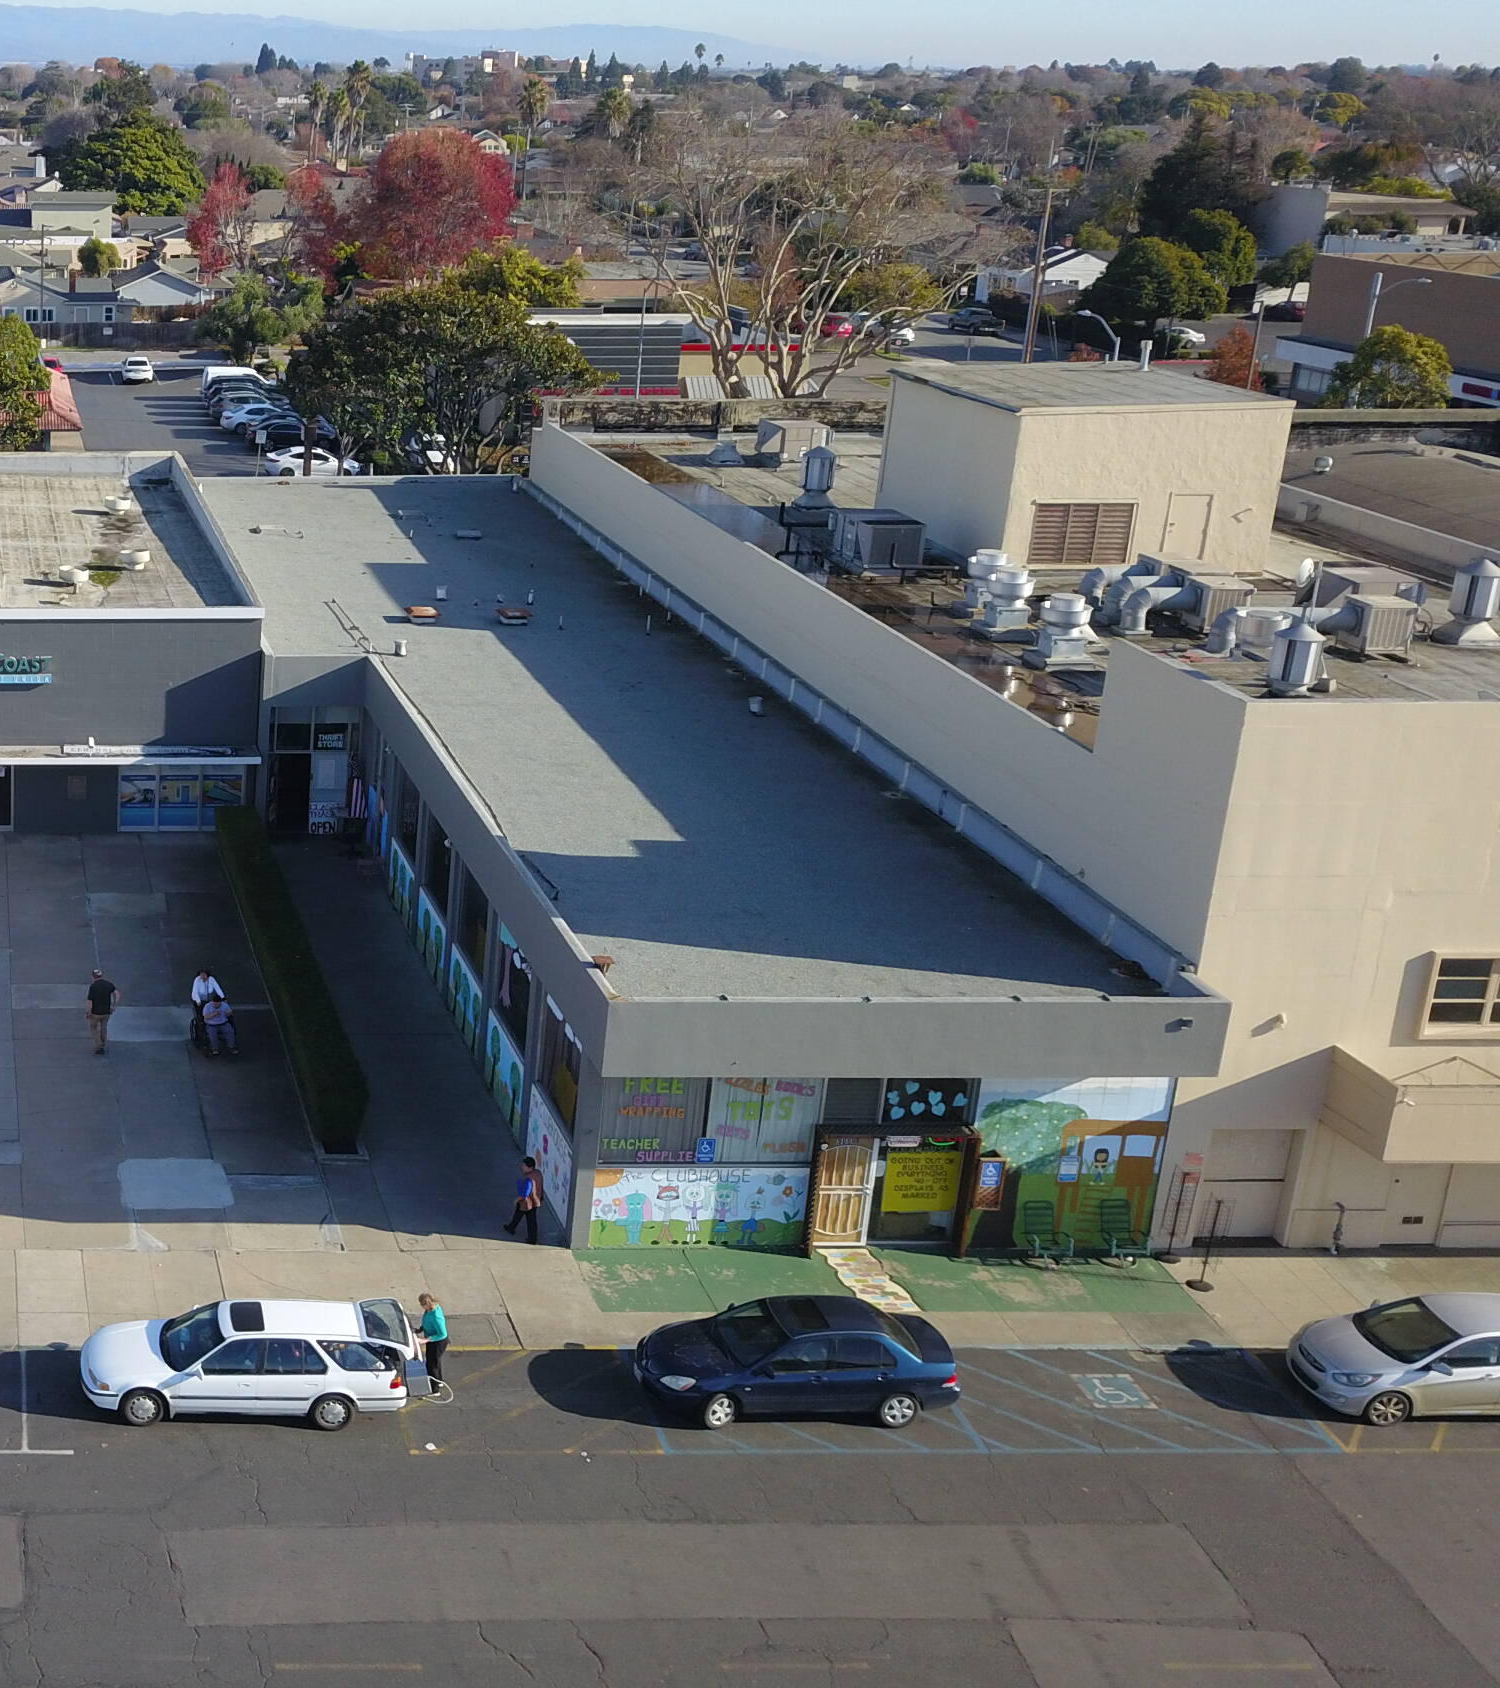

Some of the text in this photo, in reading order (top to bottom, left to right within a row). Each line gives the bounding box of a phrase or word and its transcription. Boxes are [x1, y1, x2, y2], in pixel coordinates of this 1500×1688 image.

[318, 733, 344, 741] THRIFT
[310, 821, 335, 833] OPEN
[623, 1077, 684, 1095] FREE
[619, 1106, 685, 1119] WRAPPING
[727, 1096, 795, 1120] TOYS
[601, 1137, 661, 1150] TEACHER
[636, 1151, 696, 1162] SUPPLIE
[651, 1169, 751, 1184] CLUBHOUSE
